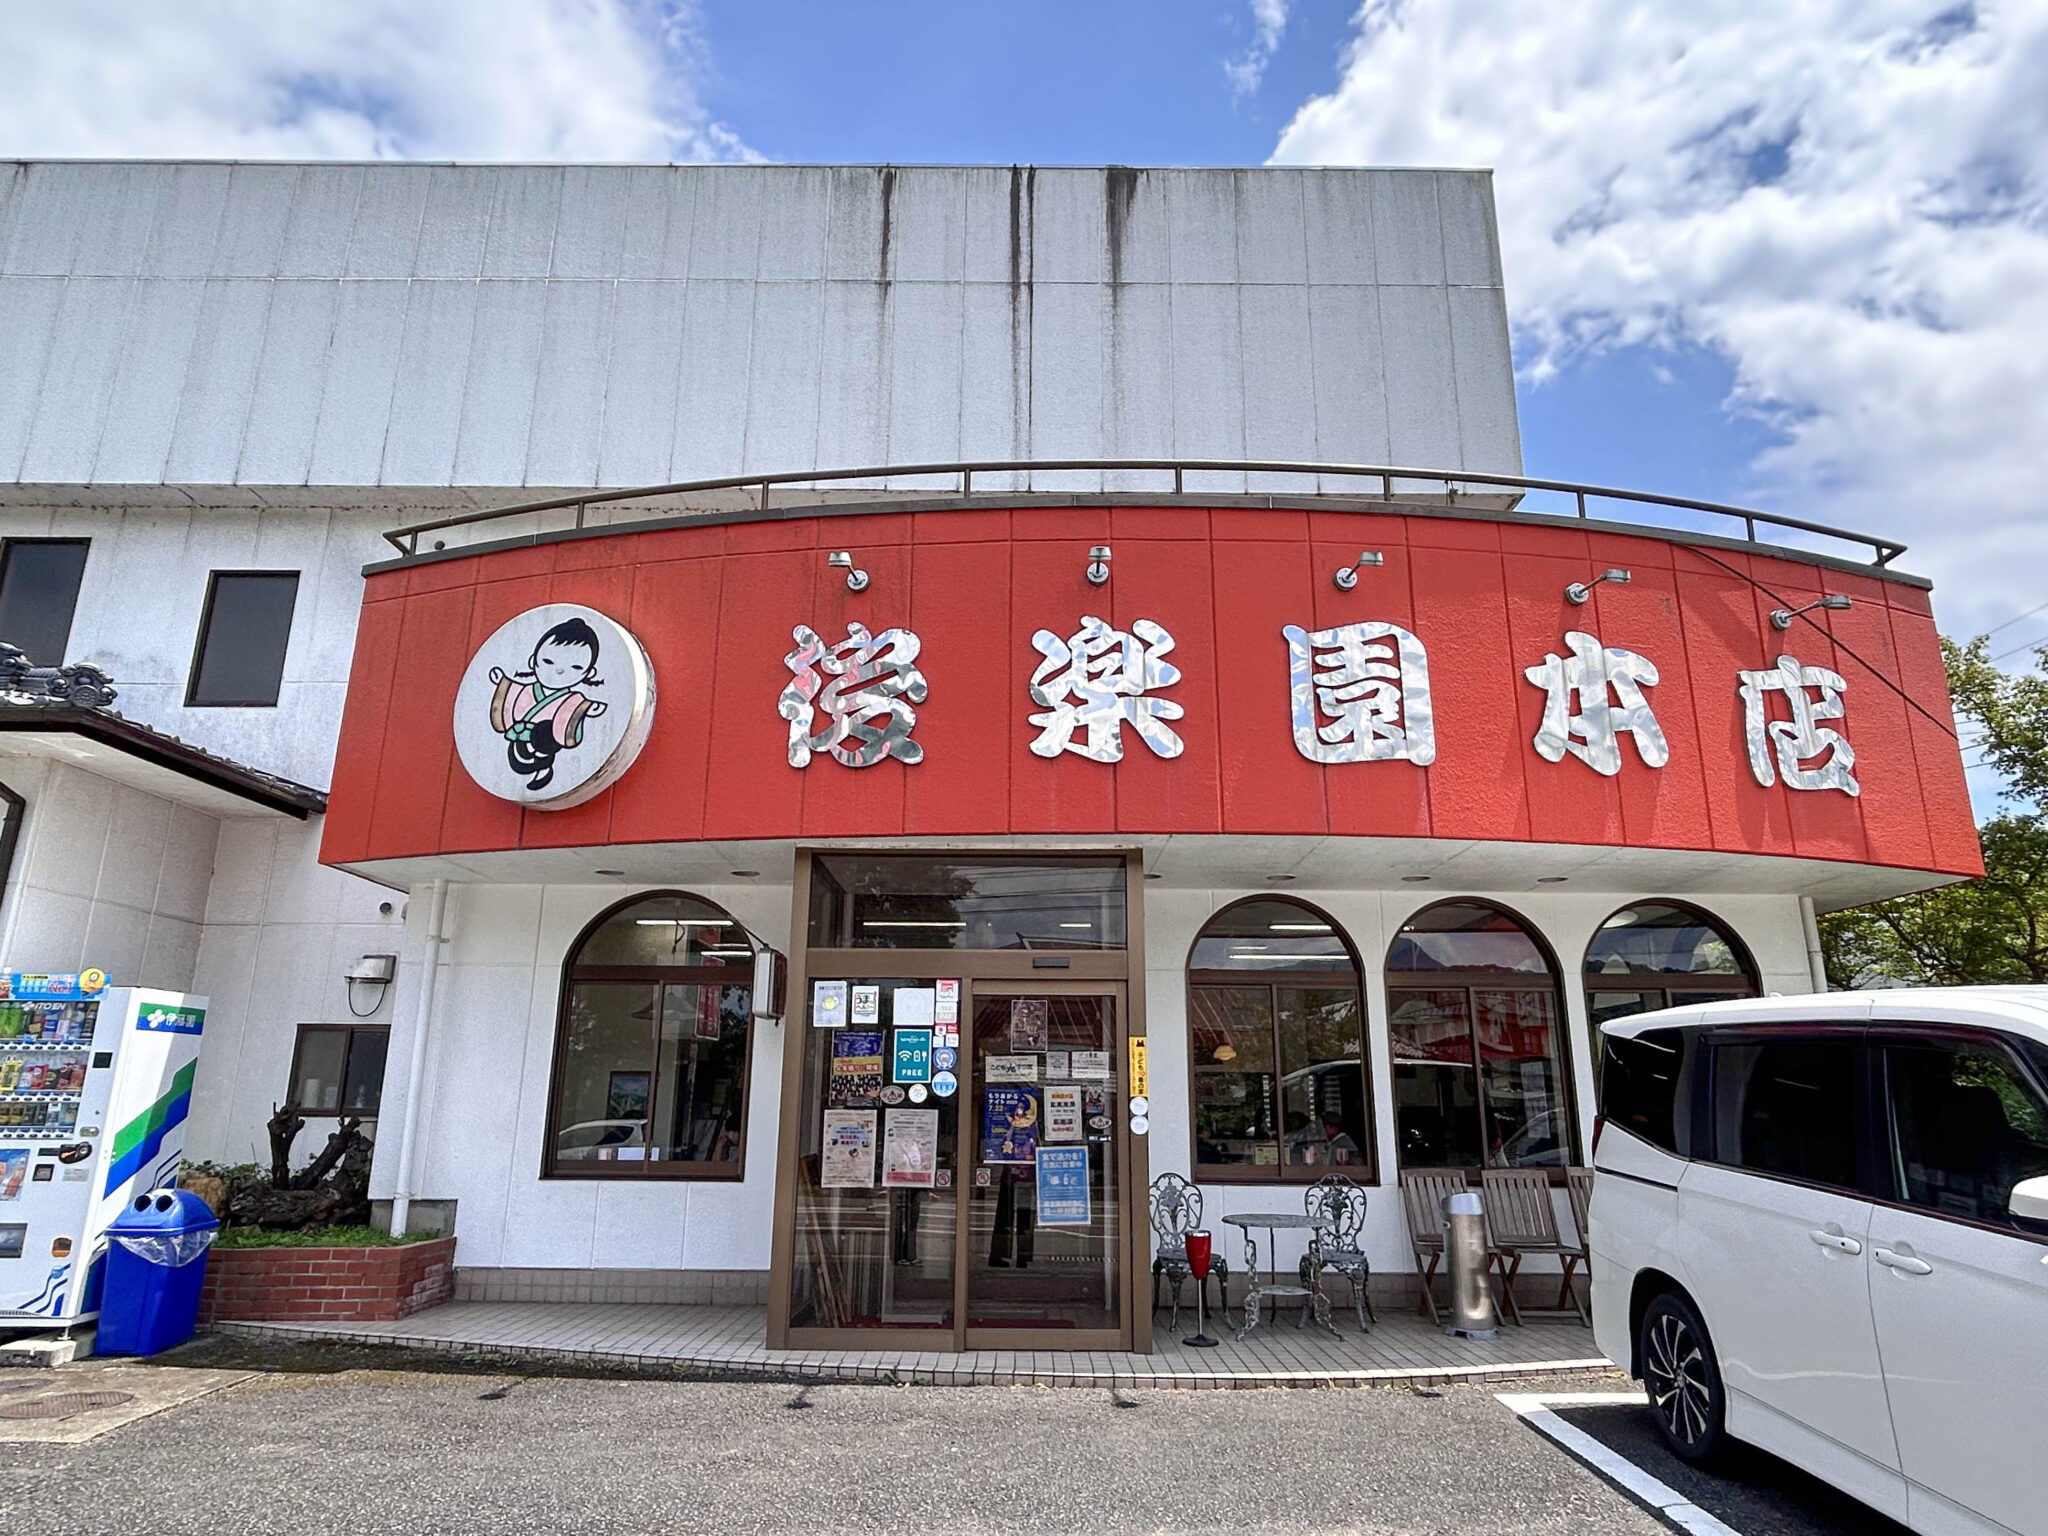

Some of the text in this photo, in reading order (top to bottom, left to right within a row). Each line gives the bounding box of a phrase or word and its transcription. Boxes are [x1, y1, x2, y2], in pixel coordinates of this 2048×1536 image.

[778, 615, 1860, 798] 後楽園本店
[34, 1002, 67, 1011] ITO EN
[901, 1068, 923, 1076] FREE
